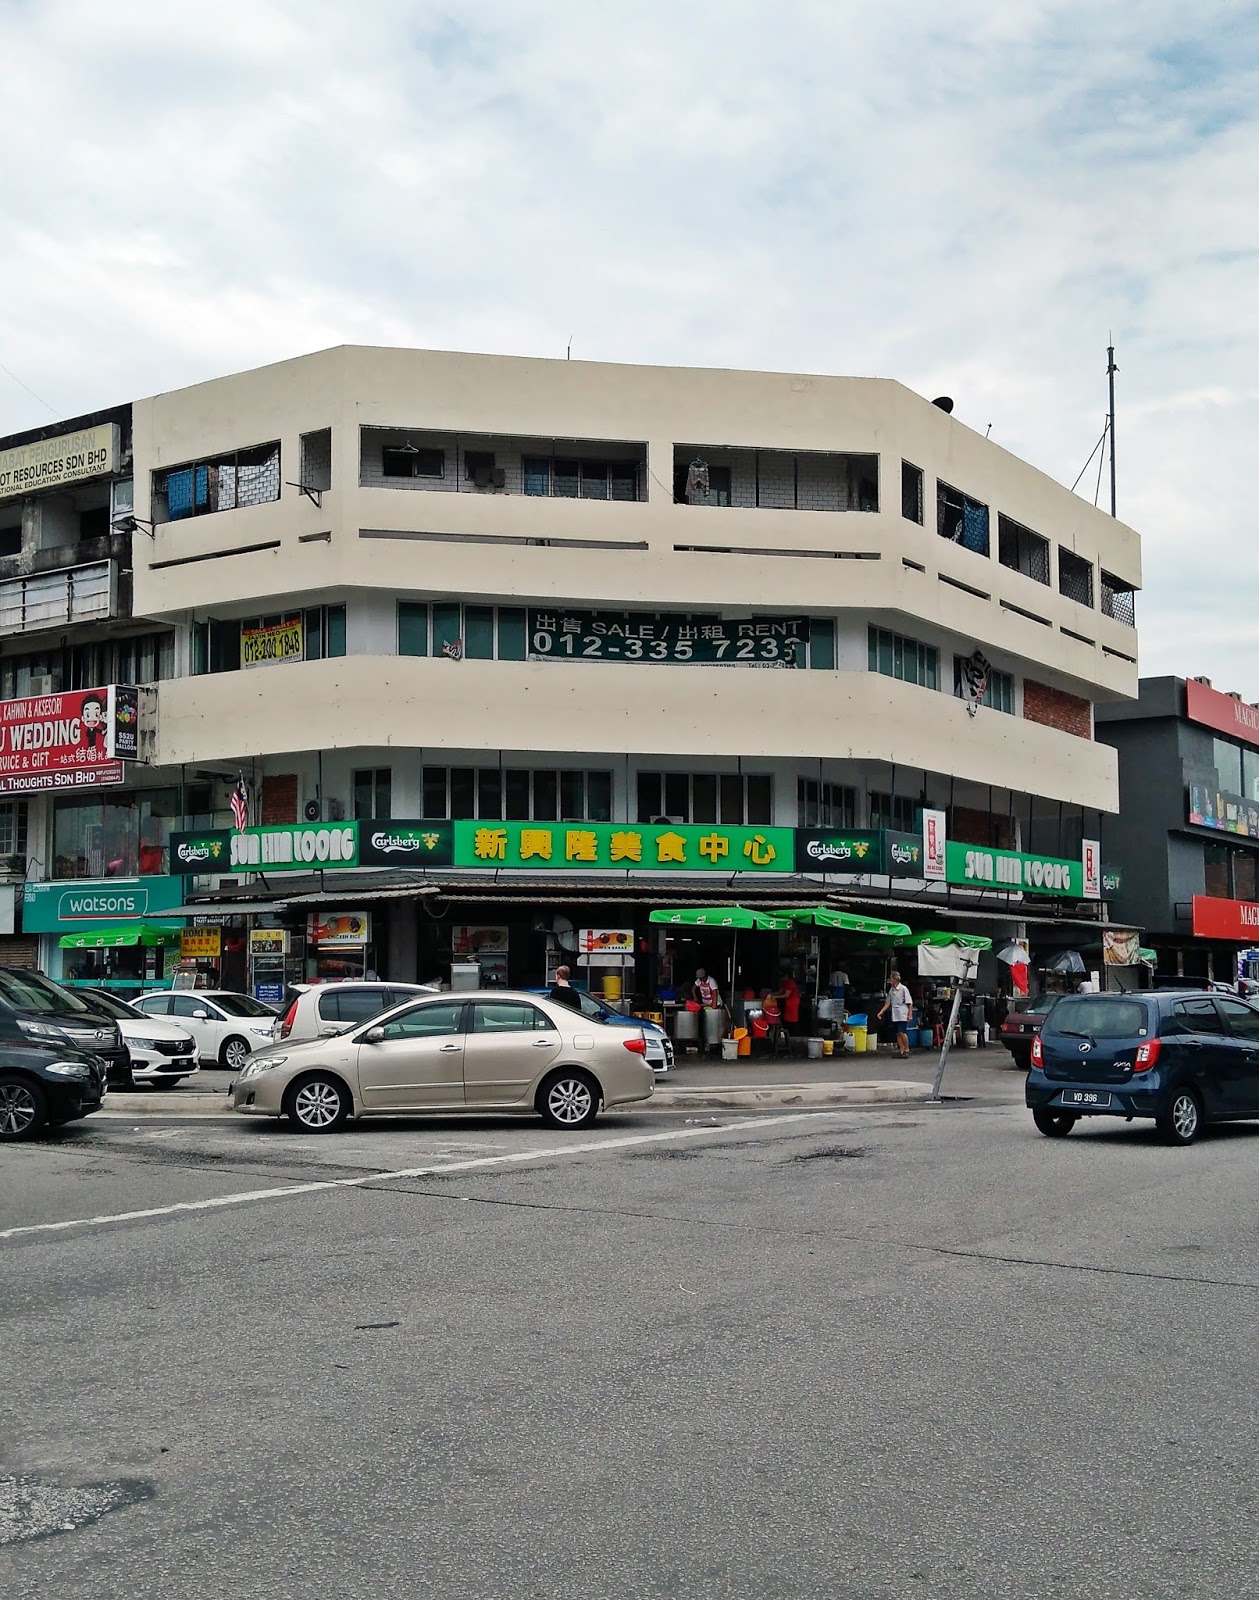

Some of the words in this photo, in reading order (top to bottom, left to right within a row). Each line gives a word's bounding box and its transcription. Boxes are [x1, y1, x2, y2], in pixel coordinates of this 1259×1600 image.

[30, 432, 96, 464] PENGURUSAN
[13, 459, 63, 483] RESOURCES
[66, 453, 84, 470] SDN
[88, 448, 107, 465] BHD
[24, 474, 61, 489] EDUCATION
[63, 462, 106, 479] CONSULTANT
[535, 614, 582, 634] 出售
[592, 622, 654, 639] SALE
[661, 626, 669, 639] /
[678, 625, 725, 641] 出租
[738, 620, 802, 637] RENT
[533, 631, 694, 660] 012-335
[3, 701, 26, 721] KAHWIN
[28, 700, 33, 719] &
[33, 697, 62, 719] AKSESORY
[10, 718, 81, 752] WEDDING
[116, 743, 137, 751] BALLOON
[118, 731, 135, 740] SS2U
[22, 756, 29, 769] &
[31, 752, 50, 769] GIFT
[7, 776, 53, 790] THOUGHTS
[54, 773, 74, 786] SDN
[75, 771, 96, 784] BHD
[177, 842, 210, 863] Carlsberg
[293, 828, 355, 863] LOONG
[371, 832, 420, 854] Carlsberg
[474, 827, 776, 865] 新興隆美食中心
[807, 840, 851, 861] Carlsberg
[1024, 860, 1071, 891] LOONG
[70, 896, 135, 912] watsons
[1073, 1093, 1083, 1102] VD
[1084, 1093, 1097, 1102] 396
